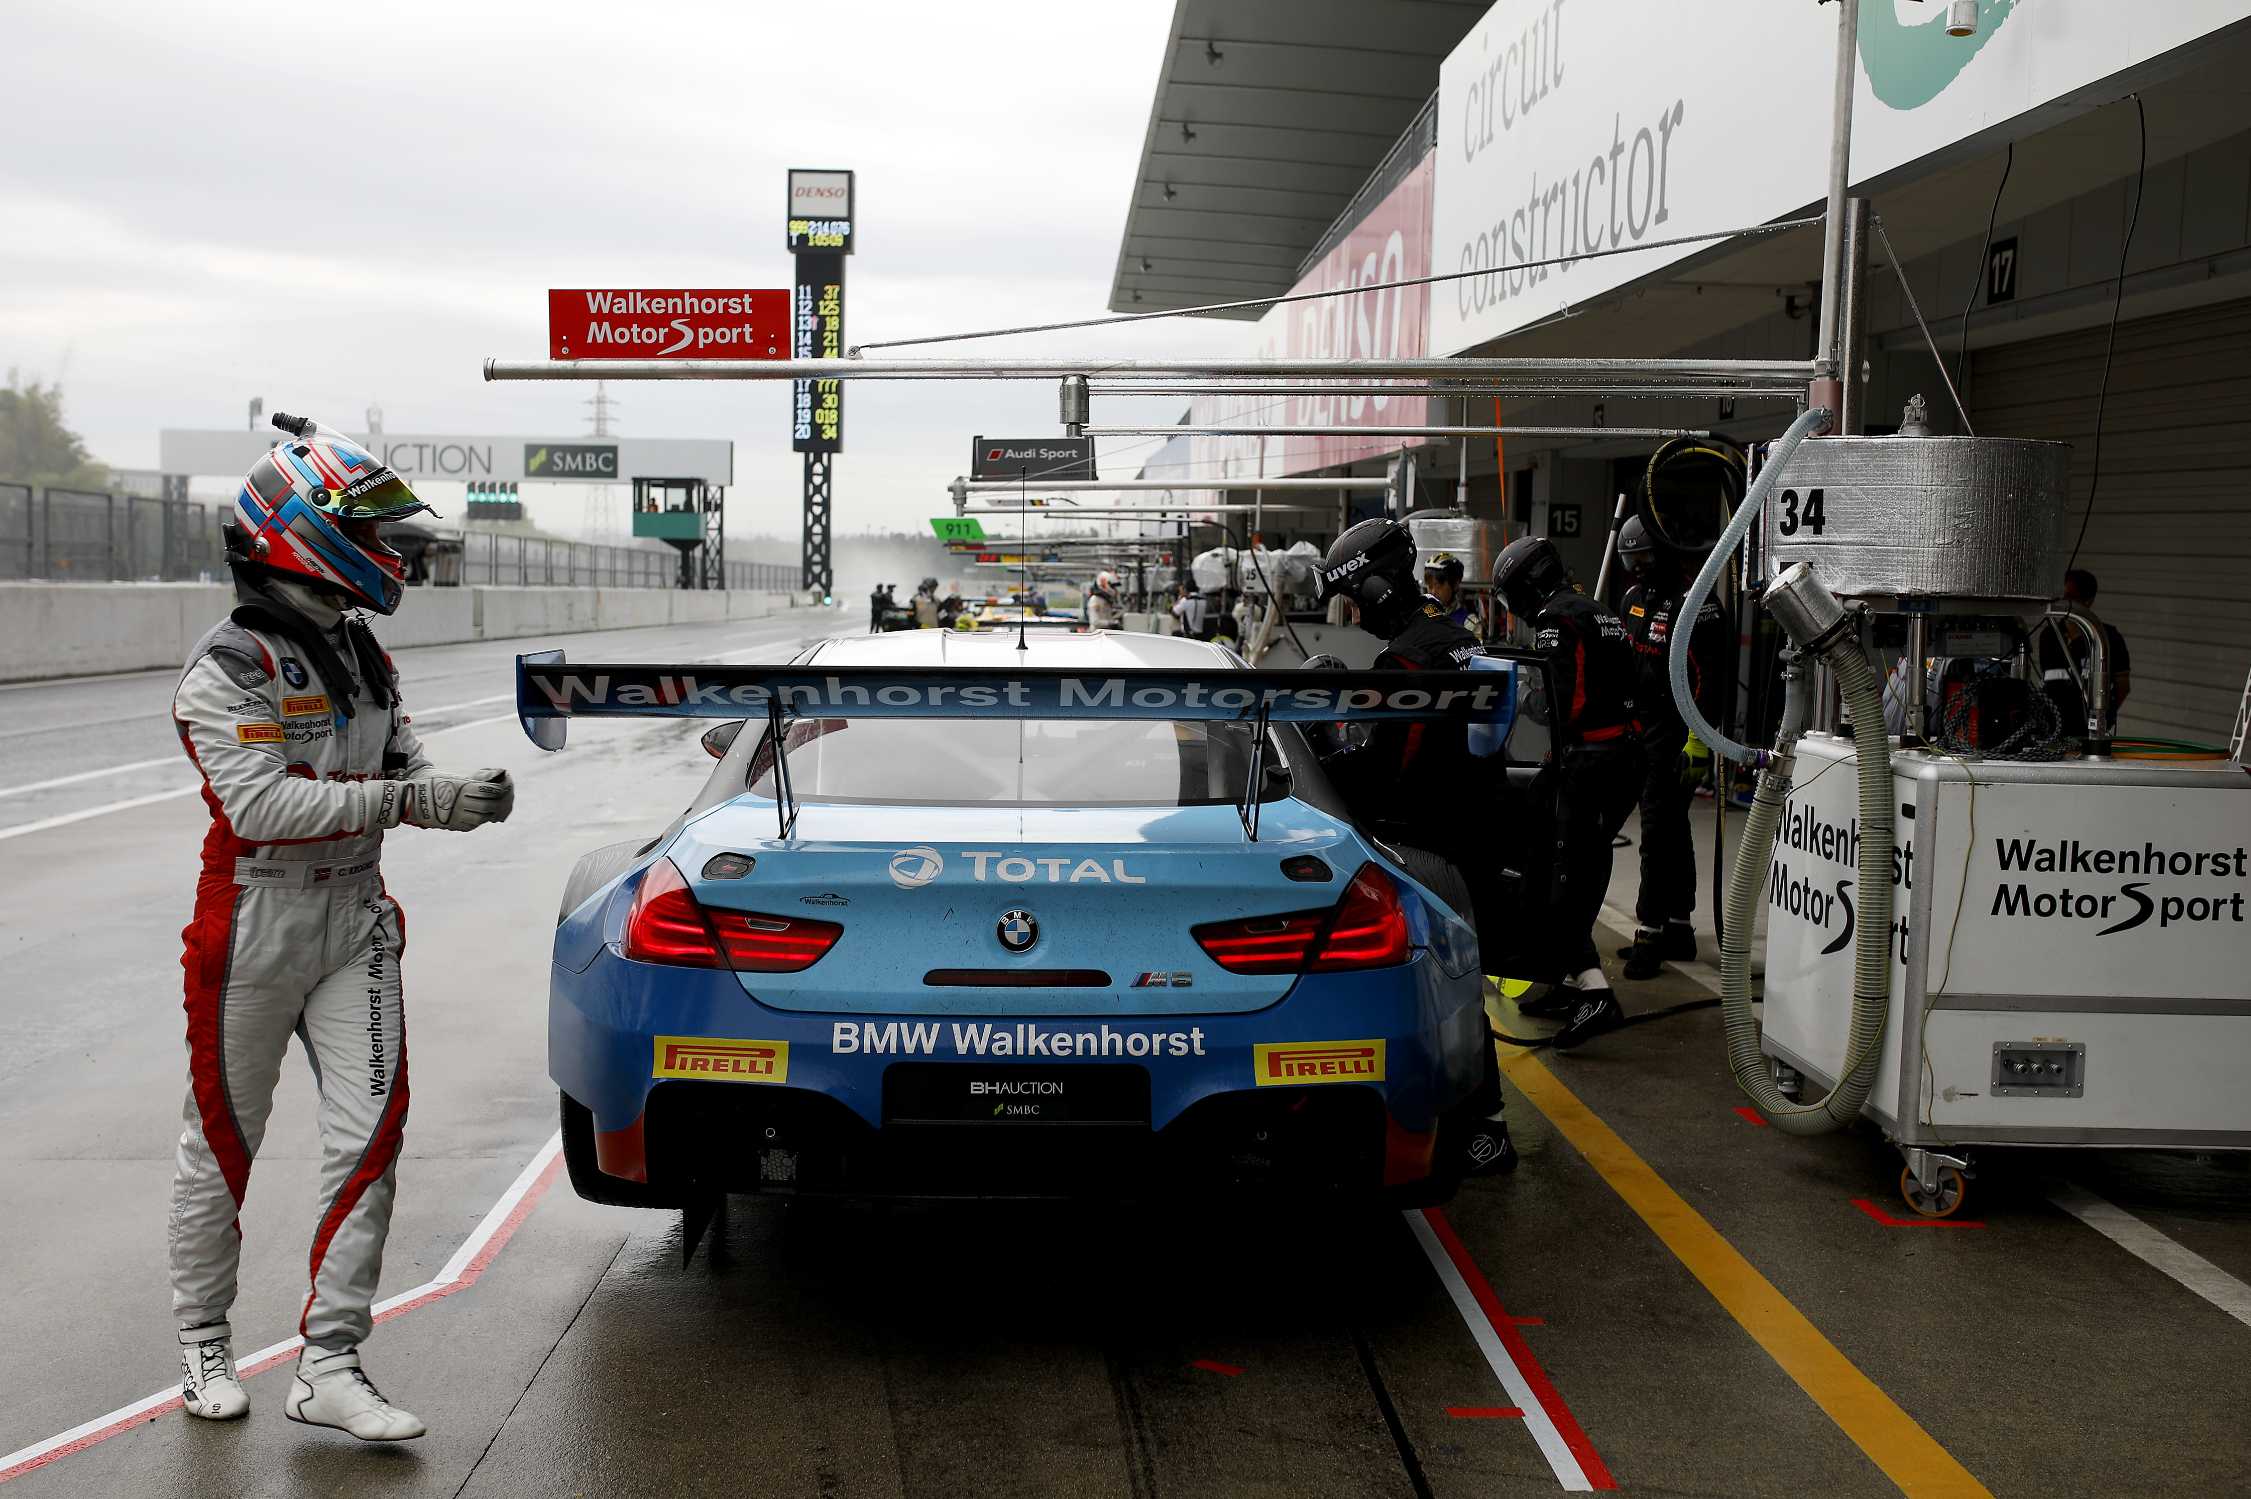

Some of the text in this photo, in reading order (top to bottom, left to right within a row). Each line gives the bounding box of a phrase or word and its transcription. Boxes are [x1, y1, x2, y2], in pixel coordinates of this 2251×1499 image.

[1464, 0, 1566, 163] circuit
[794, 186, 846, 198] DENSO
[1459, 98, 1684, 322] constructor
[1991, 249, 2014, 294] 17
[586, 291, 753, 315] Walkenhorst
[798, 285, 840, 299] 11 37
[798, 301, 840, 315] 12 125
[798, 316, 812, 330] 13
[586, 318, 754, 356] MotorSport
[798, 332, 838, 346] 14 21
[796, 394, 838, 408] 18 30
[796, 409, 811, 423] 19
[795, 424, 837, 440] 20 34
[553, 452, 613, 472] SMBC
[1004, 448, 1078, 460] Audi Sport
[1552, 510, 1579, 533] 15
[1780, 489, 1825, 536] 34
[945, 523, 971, 536] 911
[1326, 551, 1370, 583] uvex
[533, 676, 1499, 713] Walkenhorst Motorsport
[284, 729, 333, 744] otorSport
[1776, 800, 1914, 890] Walkenhst
[962, 851, 1146, 885] TOTAL
[1996, 838, 2249, 878] Walkenhorst
[804, 898, 848, 906] Walkenhorst
[1769, 860, 1909, 965] MotorSrt
[1990, 883, 2246, 937] MotorSport
[1000, 911, 1036, 926] BMW
[366, 987, 387, 1097] Walkenhorst
[832, 1022, 1206, 1057] BMW Walkenhorst
[664, 1044, 776, 1075] PIRELLI
[1268, 1047, 1376, 1077] PIRELLI
[1006, 1104, 1040, 1115] SMBC
